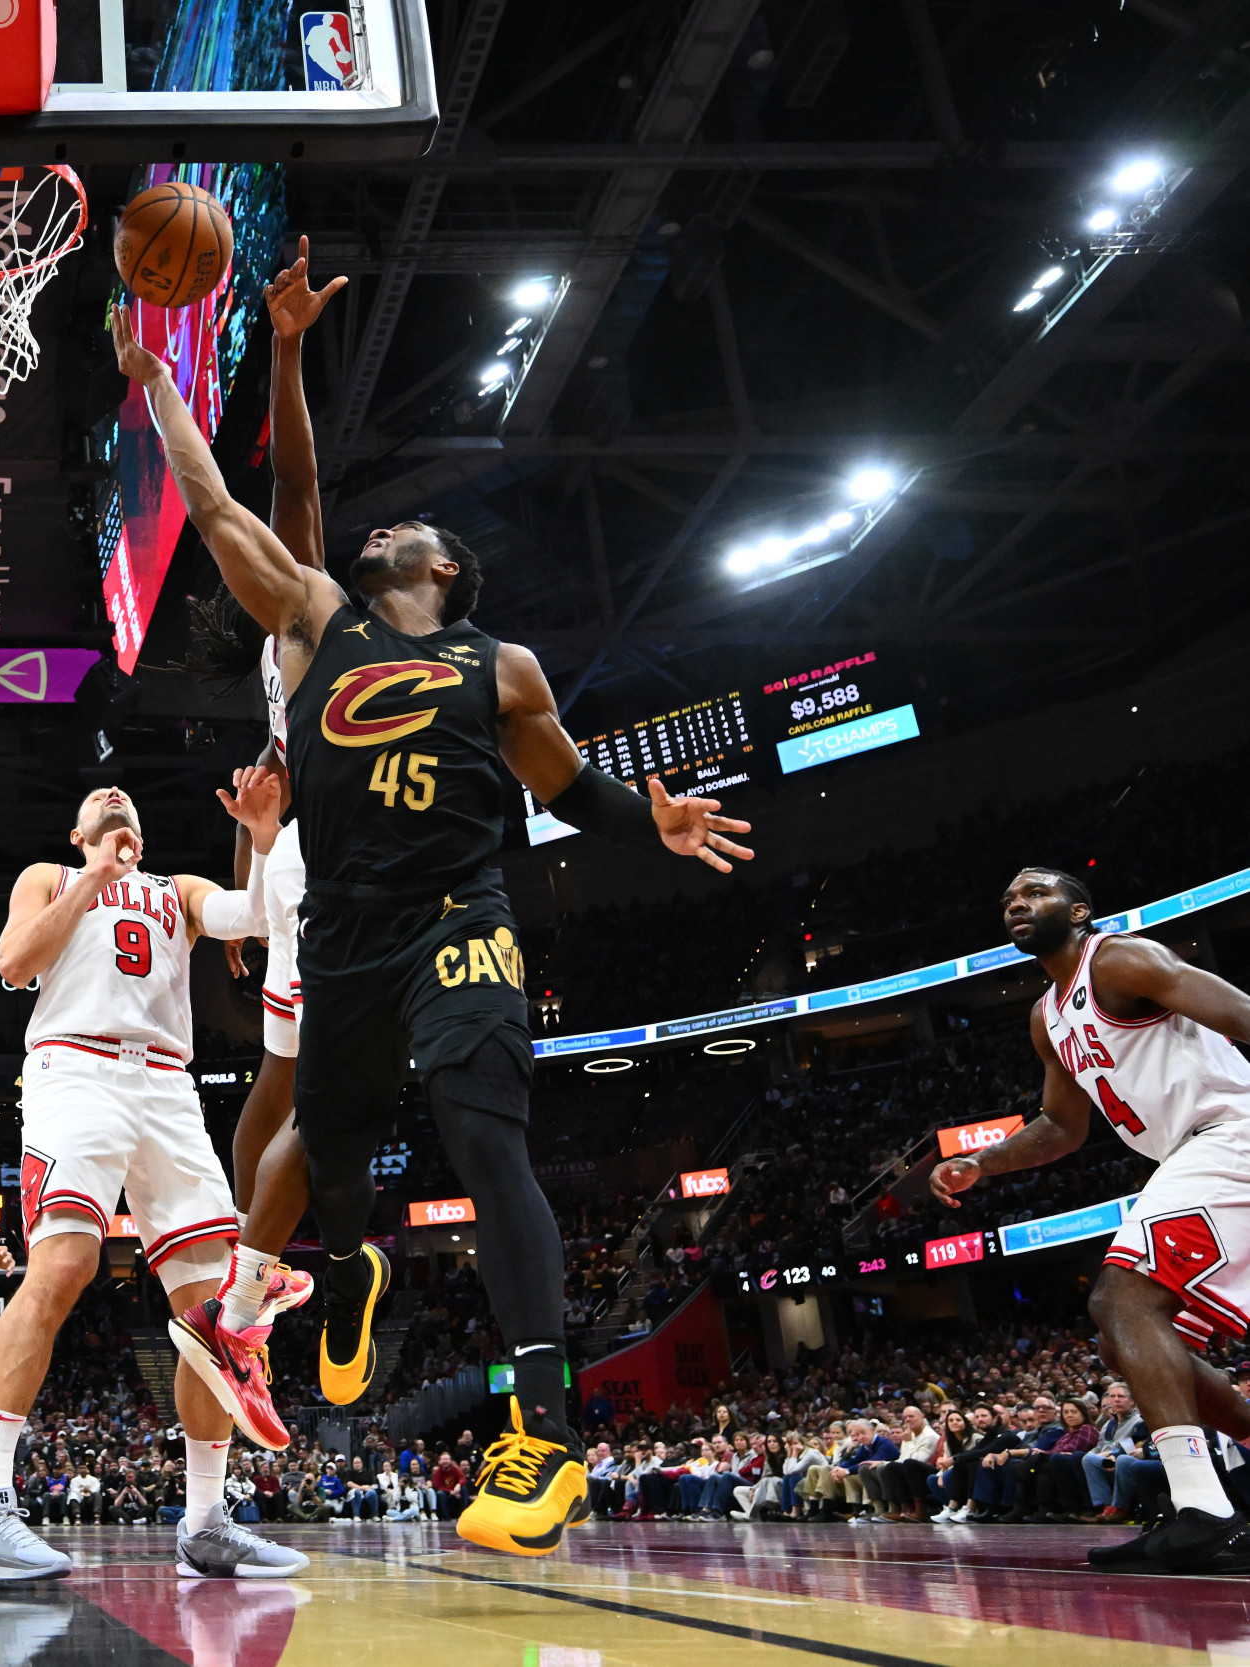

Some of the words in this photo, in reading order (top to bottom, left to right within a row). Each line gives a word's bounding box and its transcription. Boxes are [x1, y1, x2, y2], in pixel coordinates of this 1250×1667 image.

[438, 652, 480, 667] CLIFFS
[810, 651, 877, 680] RAFFLE
[790, 684, 860, 720] $9,588
[824, 717, 898, 749] CHAMPS
[368, 750, 439, 812] 45
[686, 784, 705, 797] AYO
[1194, 882, 1235, 902] Cleveland
[113, 919, 152, 979] 9
[436, 927, 525, 989] CAV
[972, 954, 999, 969] Official
[861, 981, 897, 997] Cleveland
[898, 975, 920, 989] Clinic
[667, 1024, 691, 1034] Taking
[691, 1021, 708, 1031] care
[708, 1018, 716, 1027] of
[716, 1015, 733, 1026] your
[734, 1011, 754, 1022] team
[754, 1007, 769, 1018] and
[556, 1038, 589, 1051] Cleveland
[590, 1035, 611, 1046] Clinic
[200, 1072, 236, 1085] FOULS
[244, 1071, 253, 1084] 2
[1094, 1075, 1147, 1138] 4
[957, 1124, 1005, 1152] fubo
[684, 1173, 726, 1195] fubo
[426, 1202, 465, 1222] fubo
[1042, 1221, 1081, 1238] Cleveland
[1081, 1216, 1104, 1228] Clinic
[988, 1241, 997, 1253] 2
[782, 1266, 811, 1285] 123
[821, 1265, 836, 1278] 4Q
[859, 1257, 886, 1274] 2:43
[905, 1252, 919, 1265] 12
[930, 1242, 956, 1262] 119
[742, 1280, 750, 1292] 4
[602, 1379, 641, 1396] SEAT
[611, 1397, 644, 1414] EEK
